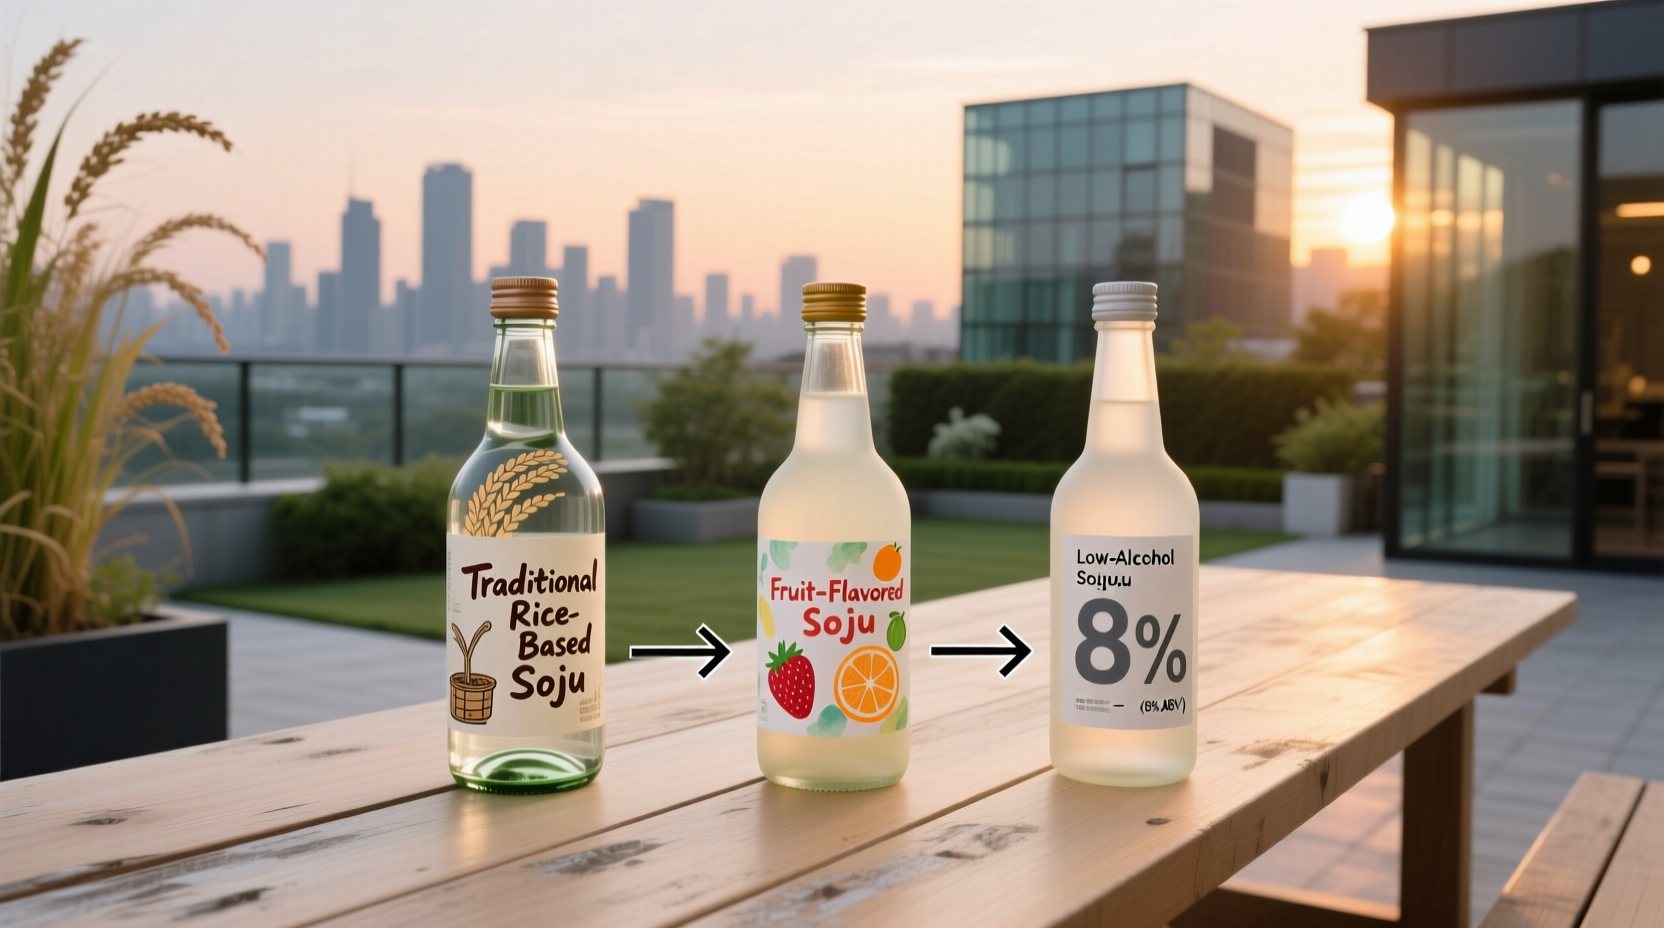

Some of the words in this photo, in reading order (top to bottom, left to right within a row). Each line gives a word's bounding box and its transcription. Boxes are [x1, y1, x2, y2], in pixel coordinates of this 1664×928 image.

[1077, 549, 1174, 565] Low-Alcohol
[461, 558, 597, 600] Traditional
[771, 577, 903, 602] Fruit-Flavored
[510, 600, 579, 630] Rice-
[803, 607, 875, 644] Soju
[518, 622, 592, 660] Based
[1075, 598, 1187, 685] 8%
[510, 664, 585, 708] Soju
